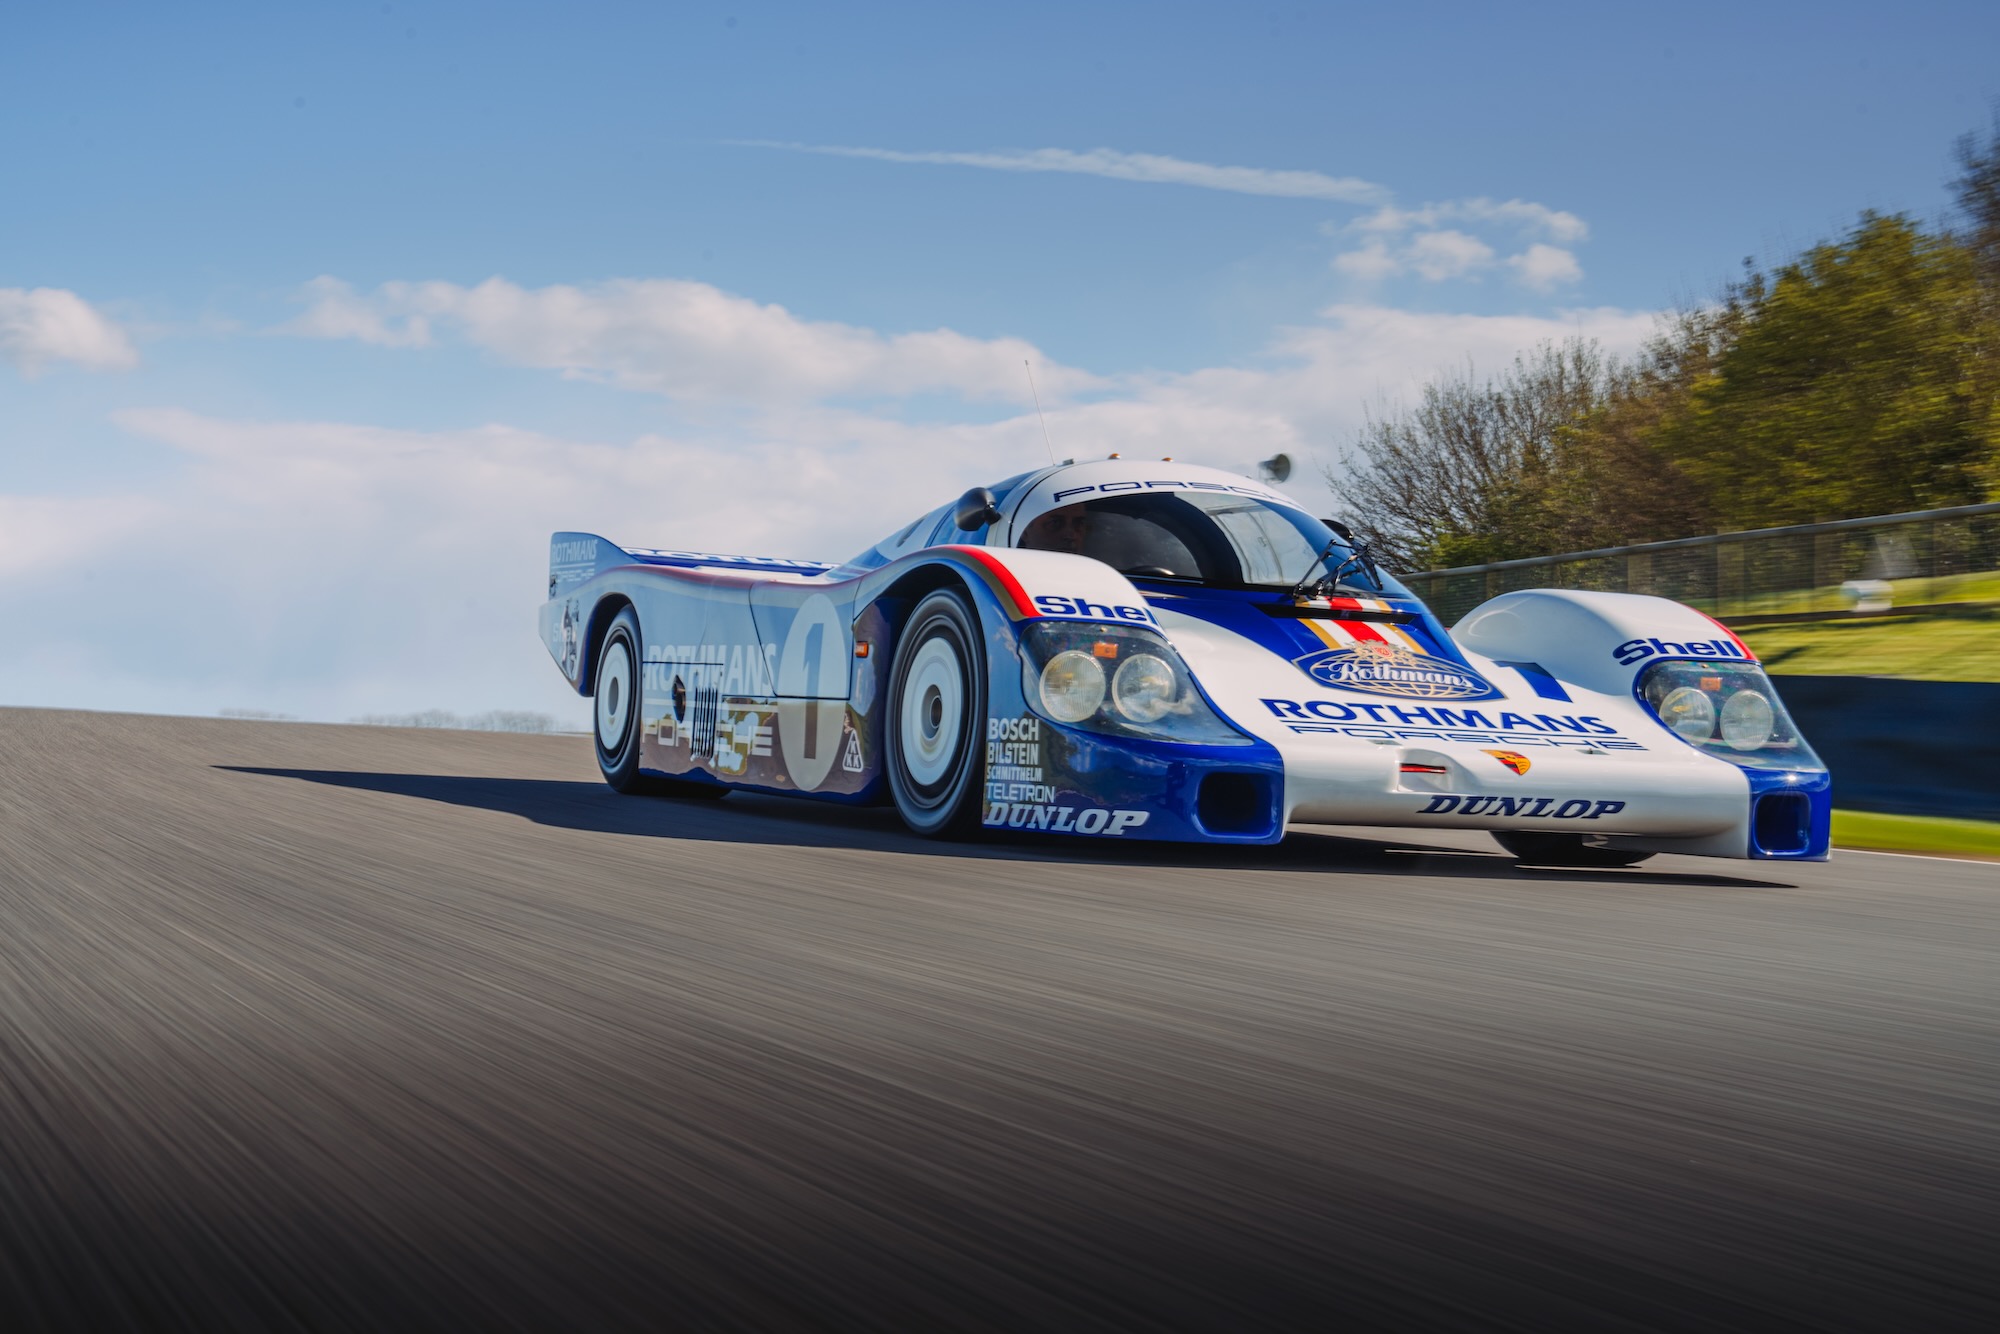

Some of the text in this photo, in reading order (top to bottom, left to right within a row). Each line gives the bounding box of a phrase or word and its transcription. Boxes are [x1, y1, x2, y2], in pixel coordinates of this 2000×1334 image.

[1612, 638, 1743, 666] Shell
[645, 643, 776, 696] ROTHMANS
[1328, 662, 1487, 692] Rothmans
[802, 622, 825, 760] 1
[988, 718, 1038, 741] BOSCH
[1259, 698, 1617, 735] ROTHMANS
[1287, 725, 1650, 751] PORSCHE
[987, 742, 1038, 765] BILSTEIN
[986, 782, 1055, 803] TELETRON
[983, 802, 1150, 836] DUNLOP
[1416, 795, 1626, 819] DUNLOP
